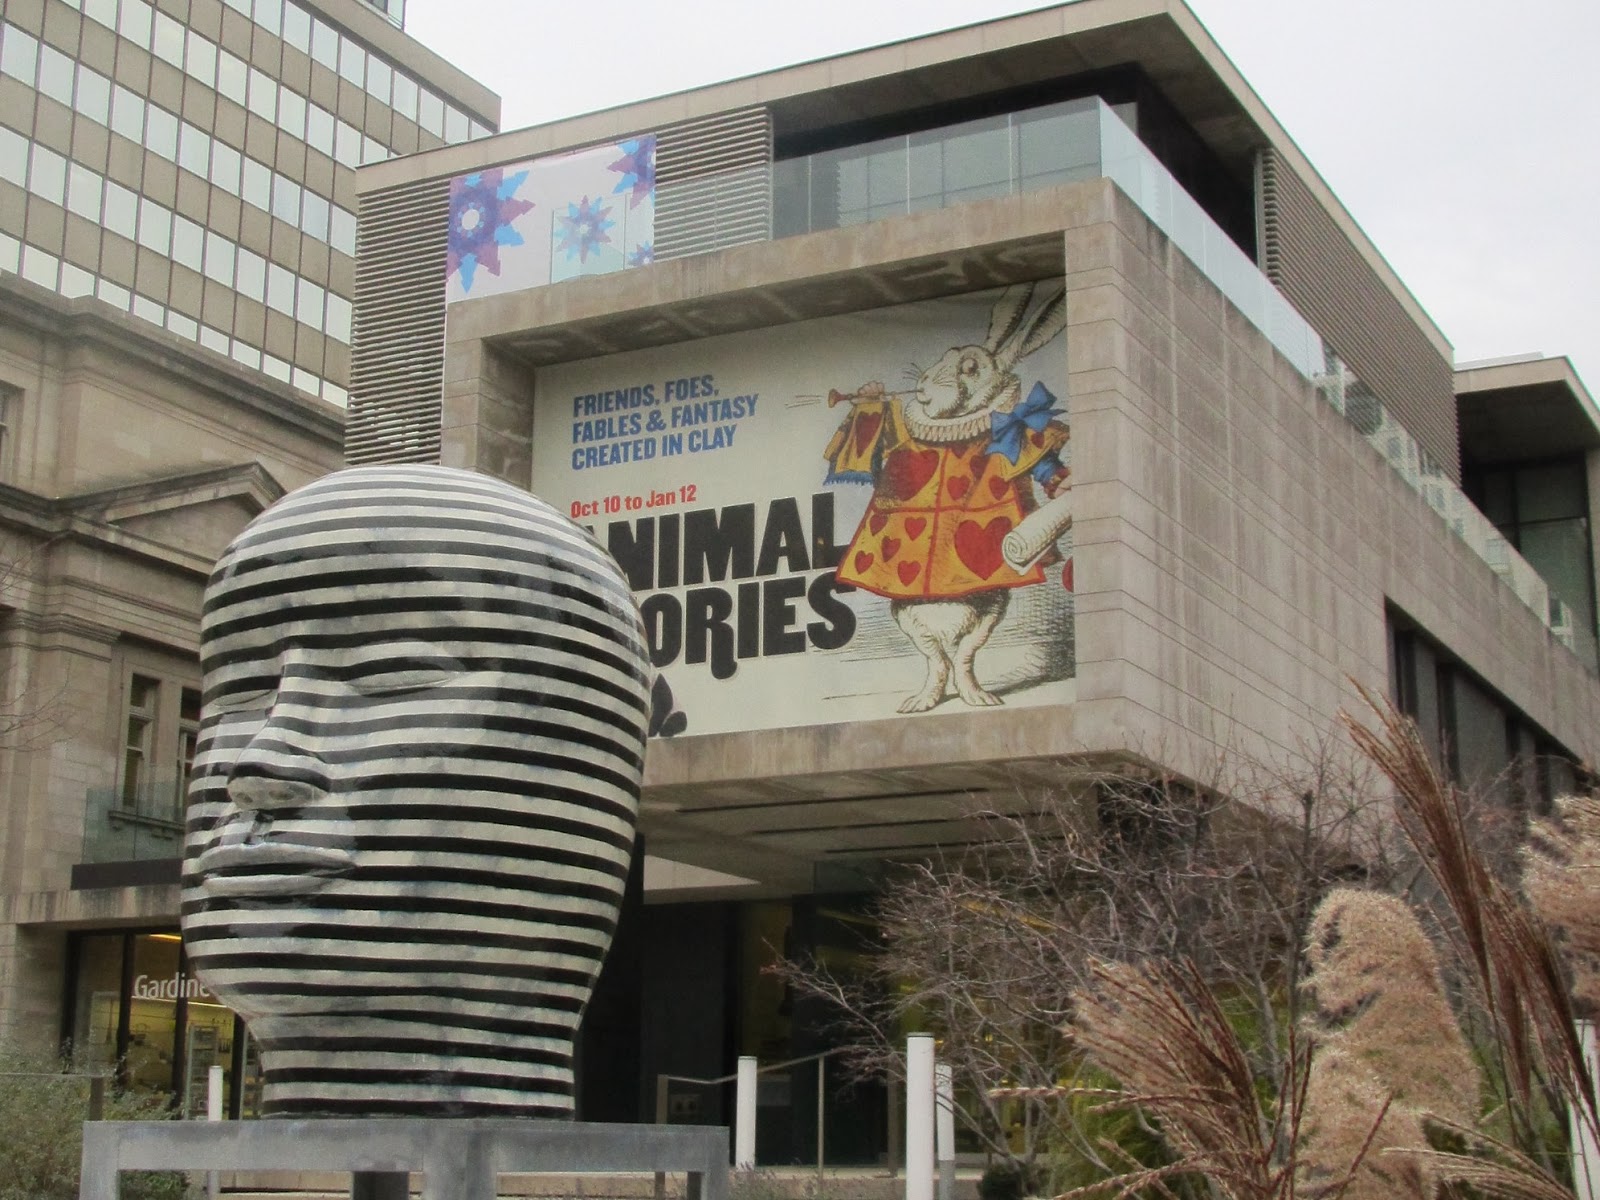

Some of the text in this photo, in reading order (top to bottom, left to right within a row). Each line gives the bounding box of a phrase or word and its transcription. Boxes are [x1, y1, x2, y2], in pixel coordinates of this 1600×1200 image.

[572, 393, 759, 444] FABLES & FANTASY
[573, 374, 719, 417] FRIENDS, FOES,
[572, 424, 737, 471] CREATED IN CLAY
[571, 484, 697, 518] Oct 10 to Jan 12
[586, 491, 850, 592] NIMAL
[640, 571, 857, 680] ORIES
[134, 971, 210, 998] Gardine
